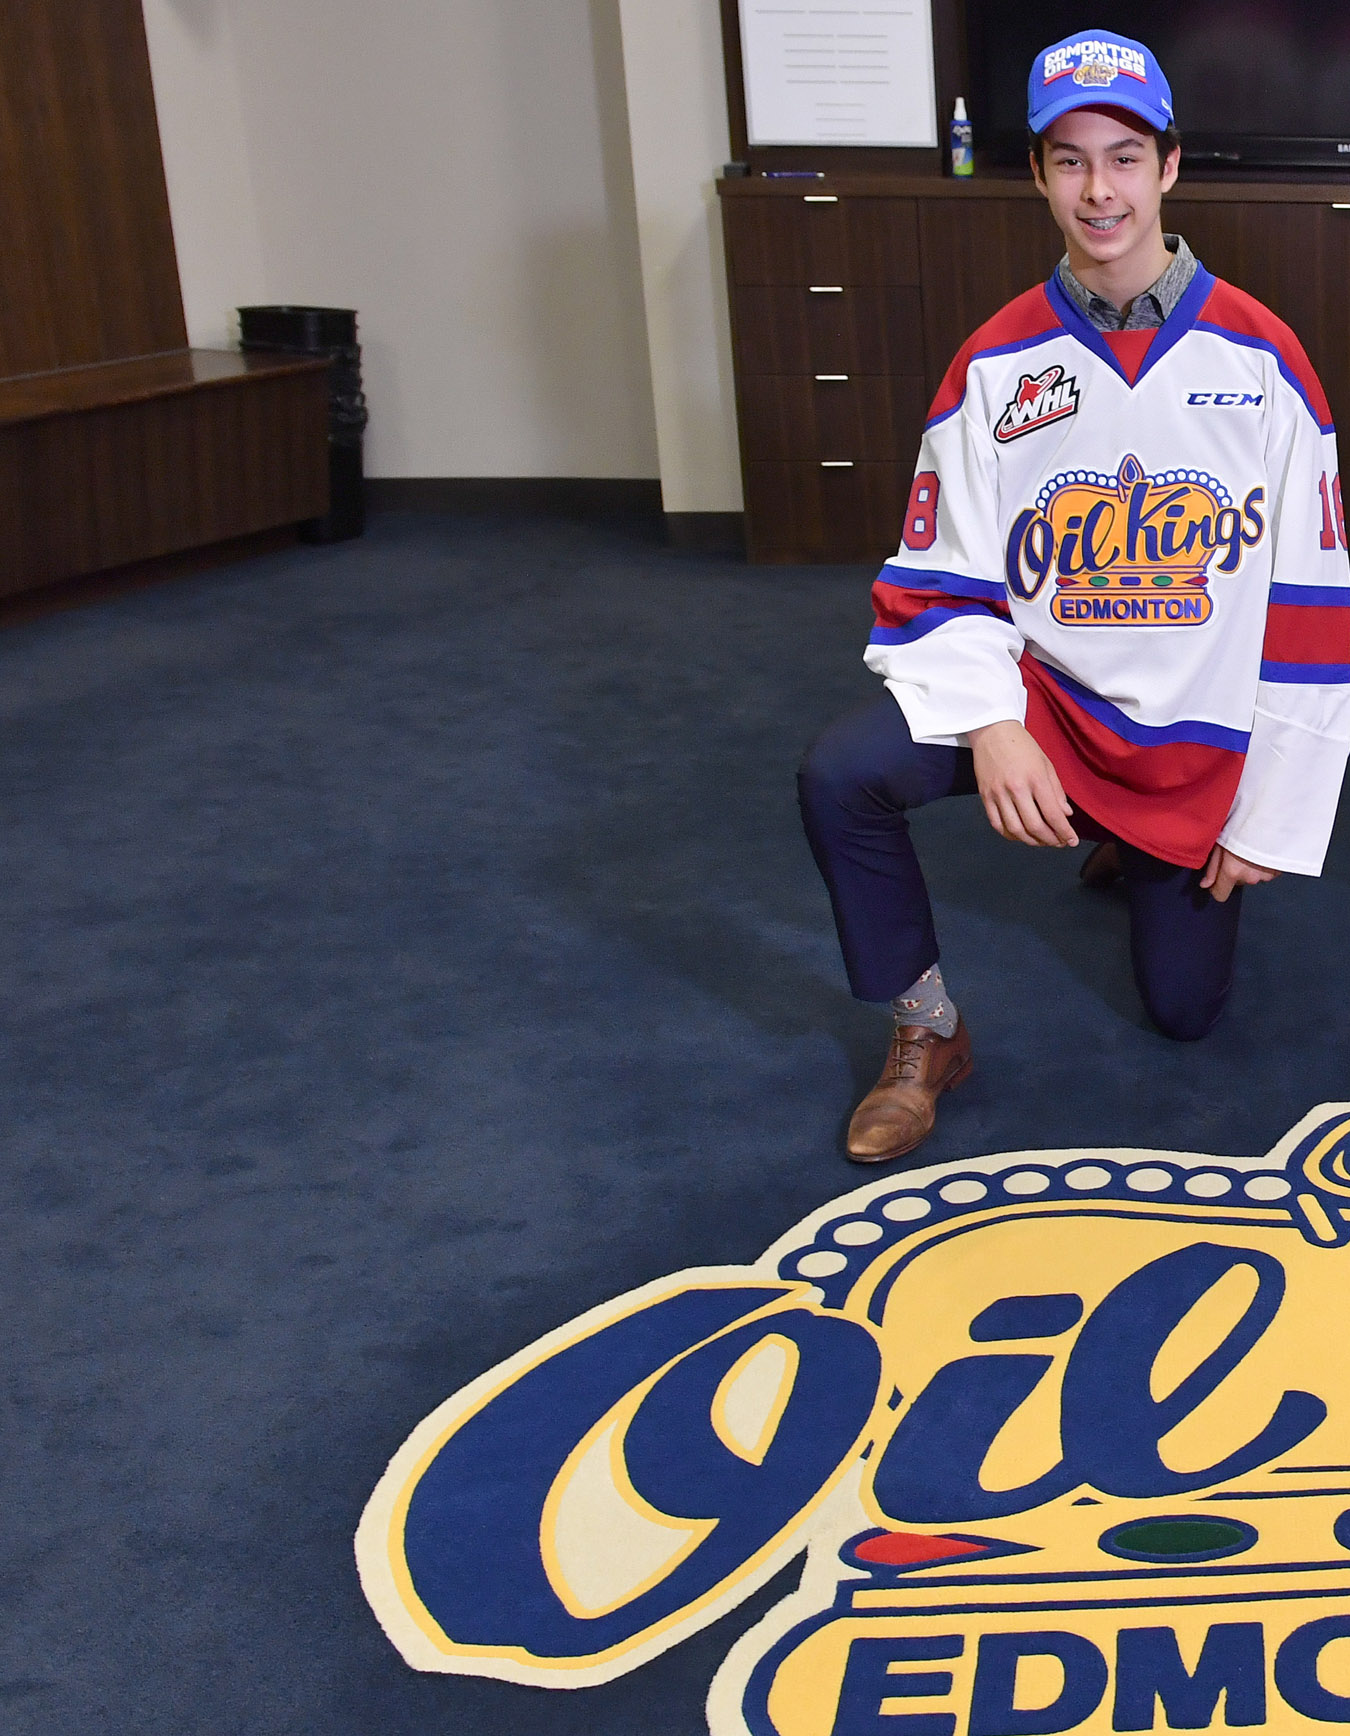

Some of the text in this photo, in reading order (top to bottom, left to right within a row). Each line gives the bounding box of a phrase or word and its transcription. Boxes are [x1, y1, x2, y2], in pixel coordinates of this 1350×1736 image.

[1044, 41, 1146, 68] EDMONTON
[1044, 59, 1074, 79] OIL
[1081, 53, 1146, 78] KINGS
[1003, 380, 1077, 431] WHL
[1186, 392, 1264, 407] CCM
[902, 471, 941, 552] 8
[1006, 482, 1265, 600] Oil Kings
[1060, 598, 1201, 620] EDMONTON
[403, 1241, 1327, 1657] Oil
